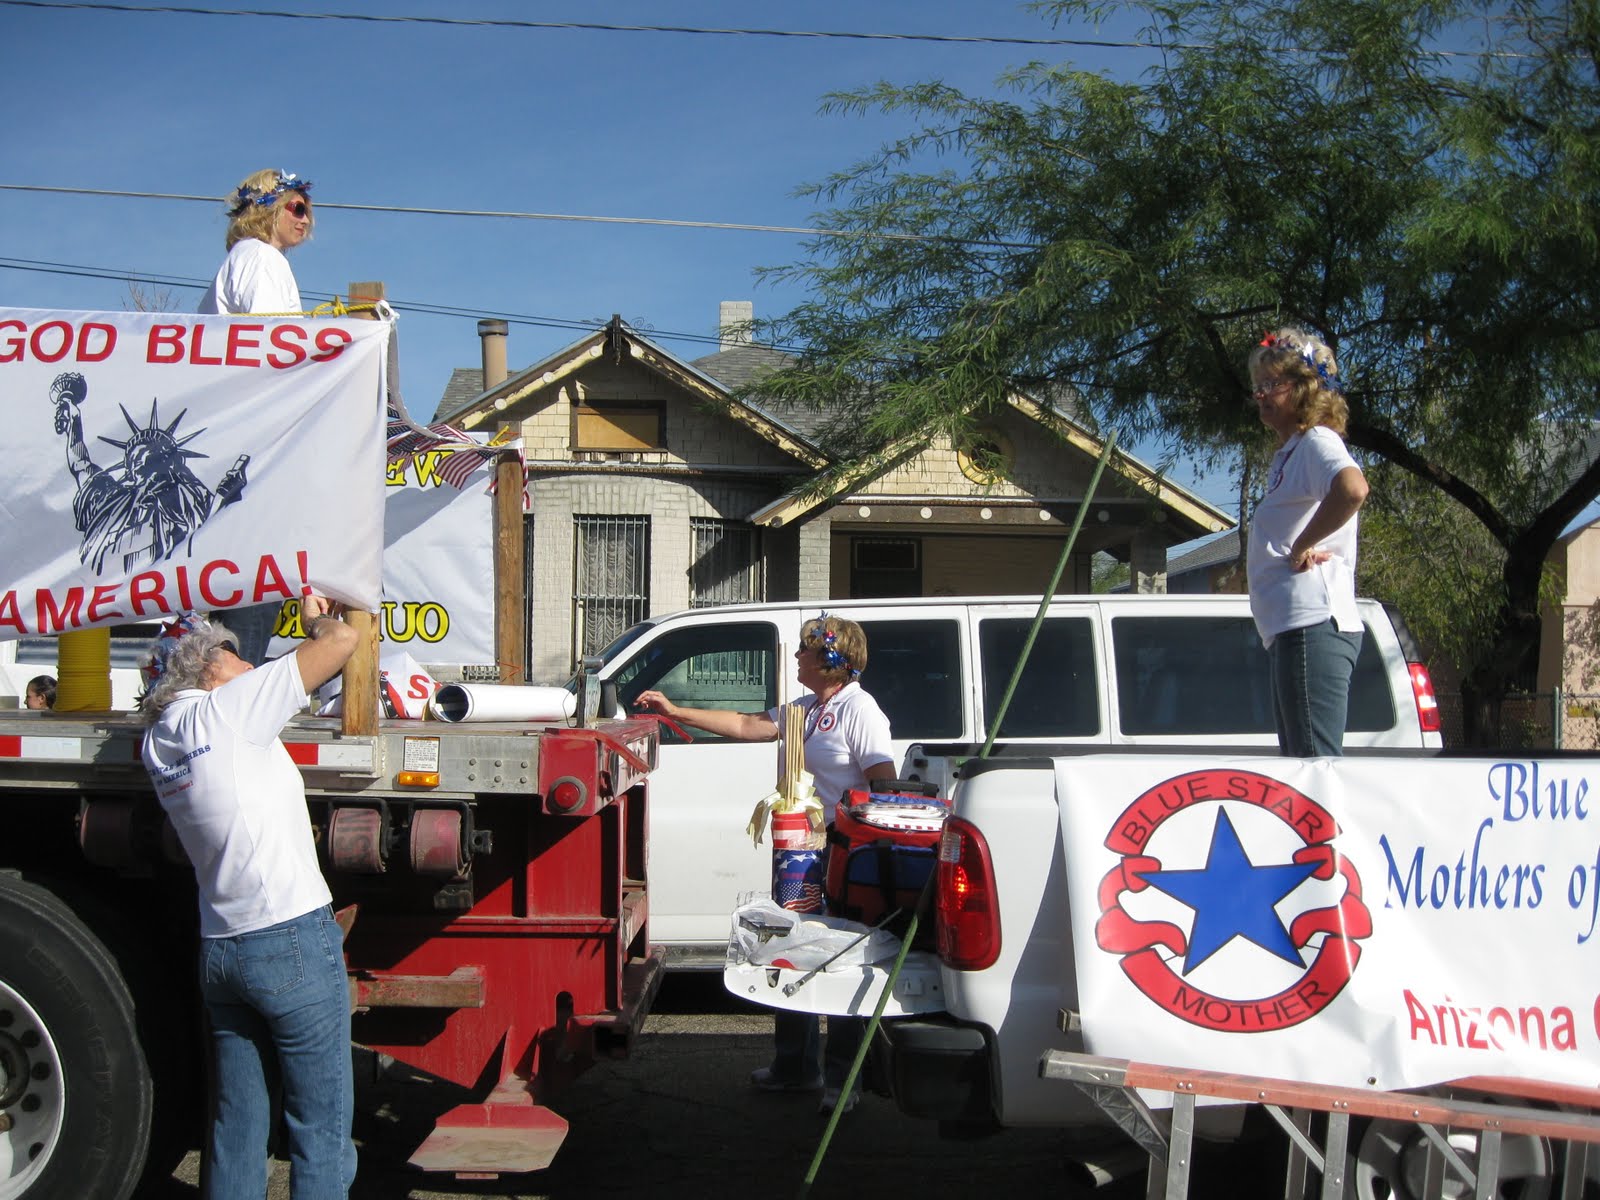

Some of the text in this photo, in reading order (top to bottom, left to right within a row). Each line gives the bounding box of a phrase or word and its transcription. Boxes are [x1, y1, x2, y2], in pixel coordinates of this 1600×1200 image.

[0, 319, 352, 369] GOD BLESS
[0, 551, 313, 634] AMERICA!
[1120, 776, 1324, 846] BLUE STAR
[1487, 761, 1589, 822] Blue
[1378, 817, 1545, 910] Mothers
[1172, 980, 1330, 1026] MOTHER
[1402, 989, 1577, 1052] Arizona
